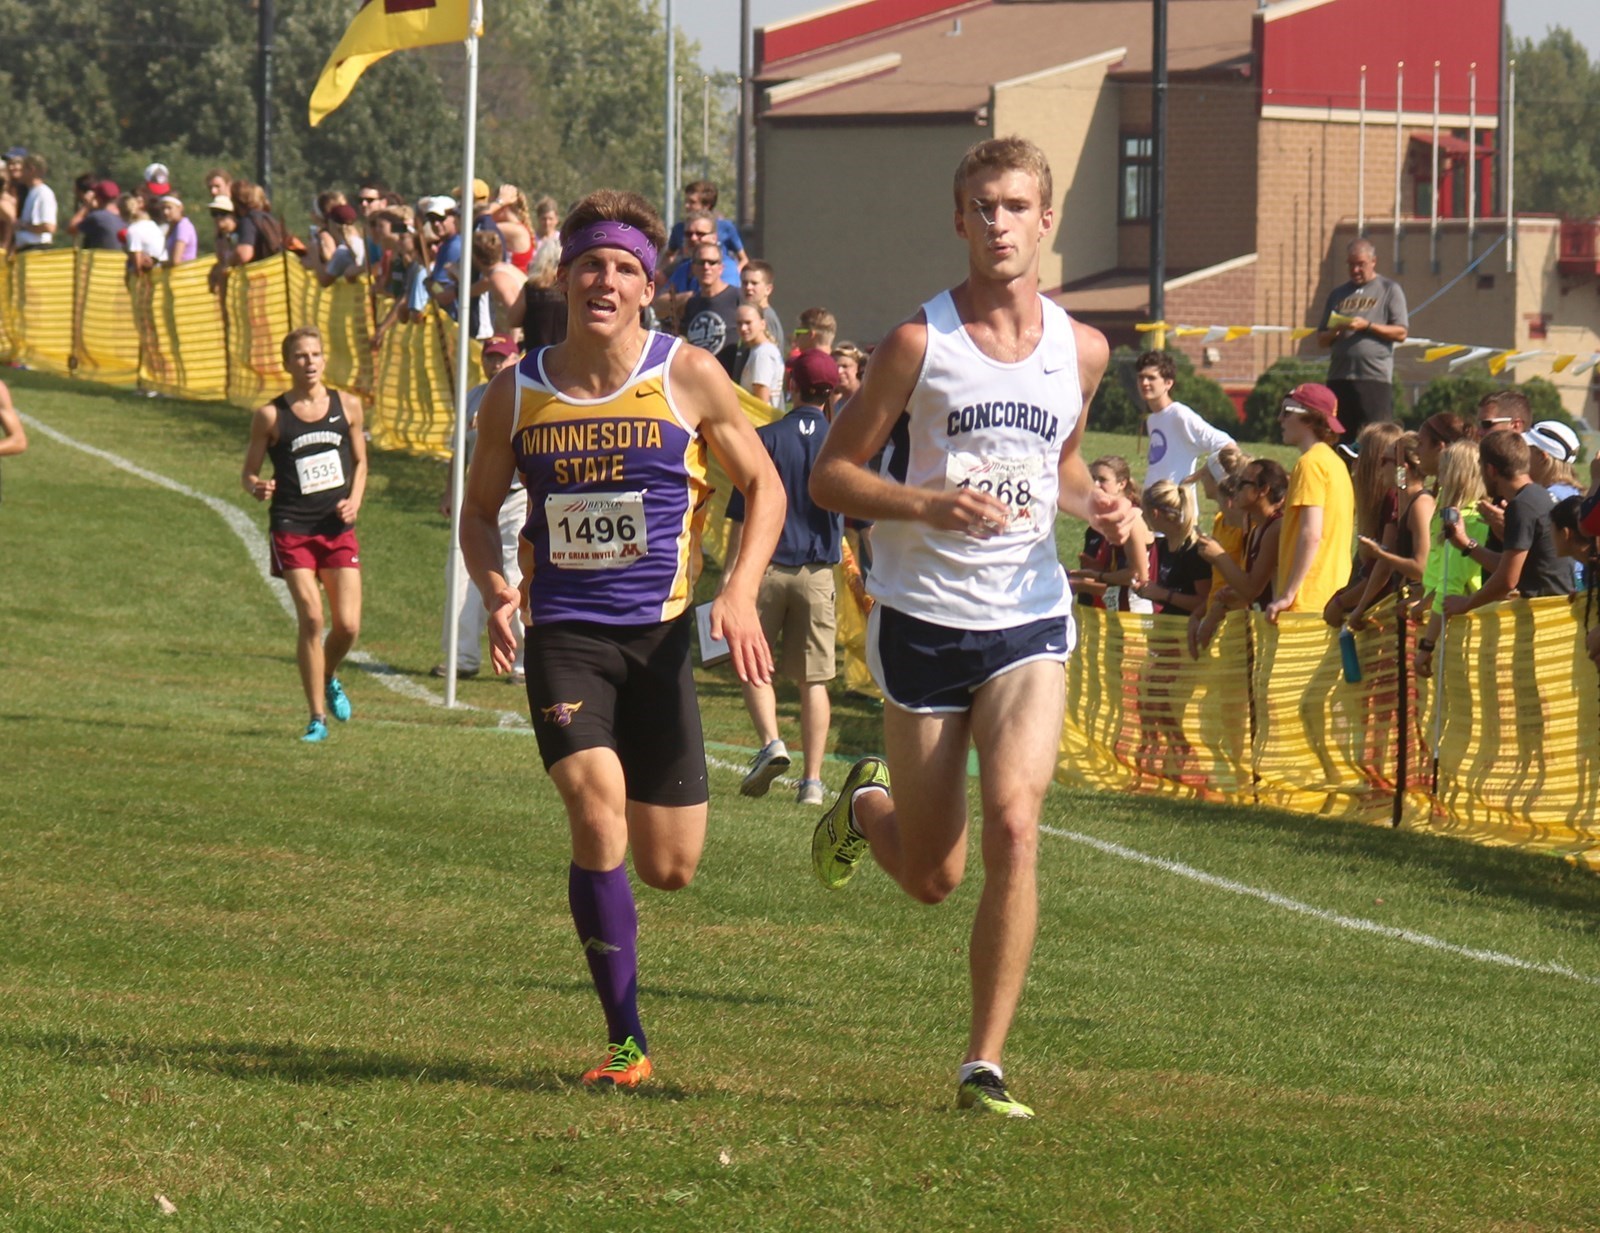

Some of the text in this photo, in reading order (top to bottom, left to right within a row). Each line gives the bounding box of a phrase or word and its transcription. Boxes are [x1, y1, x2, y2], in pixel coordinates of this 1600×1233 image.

[946, 401, 1059, 445] CONCORDIA
[522, 421, 662, 455] MINNESOTA
[303, 462, 337, 481] 1535
[554, 455, 624, 484] STATE
[558, 515, 636, 544] 1496
[552, 551, 566, 560] ROY
[592, 550, 616, 560] INVITE
